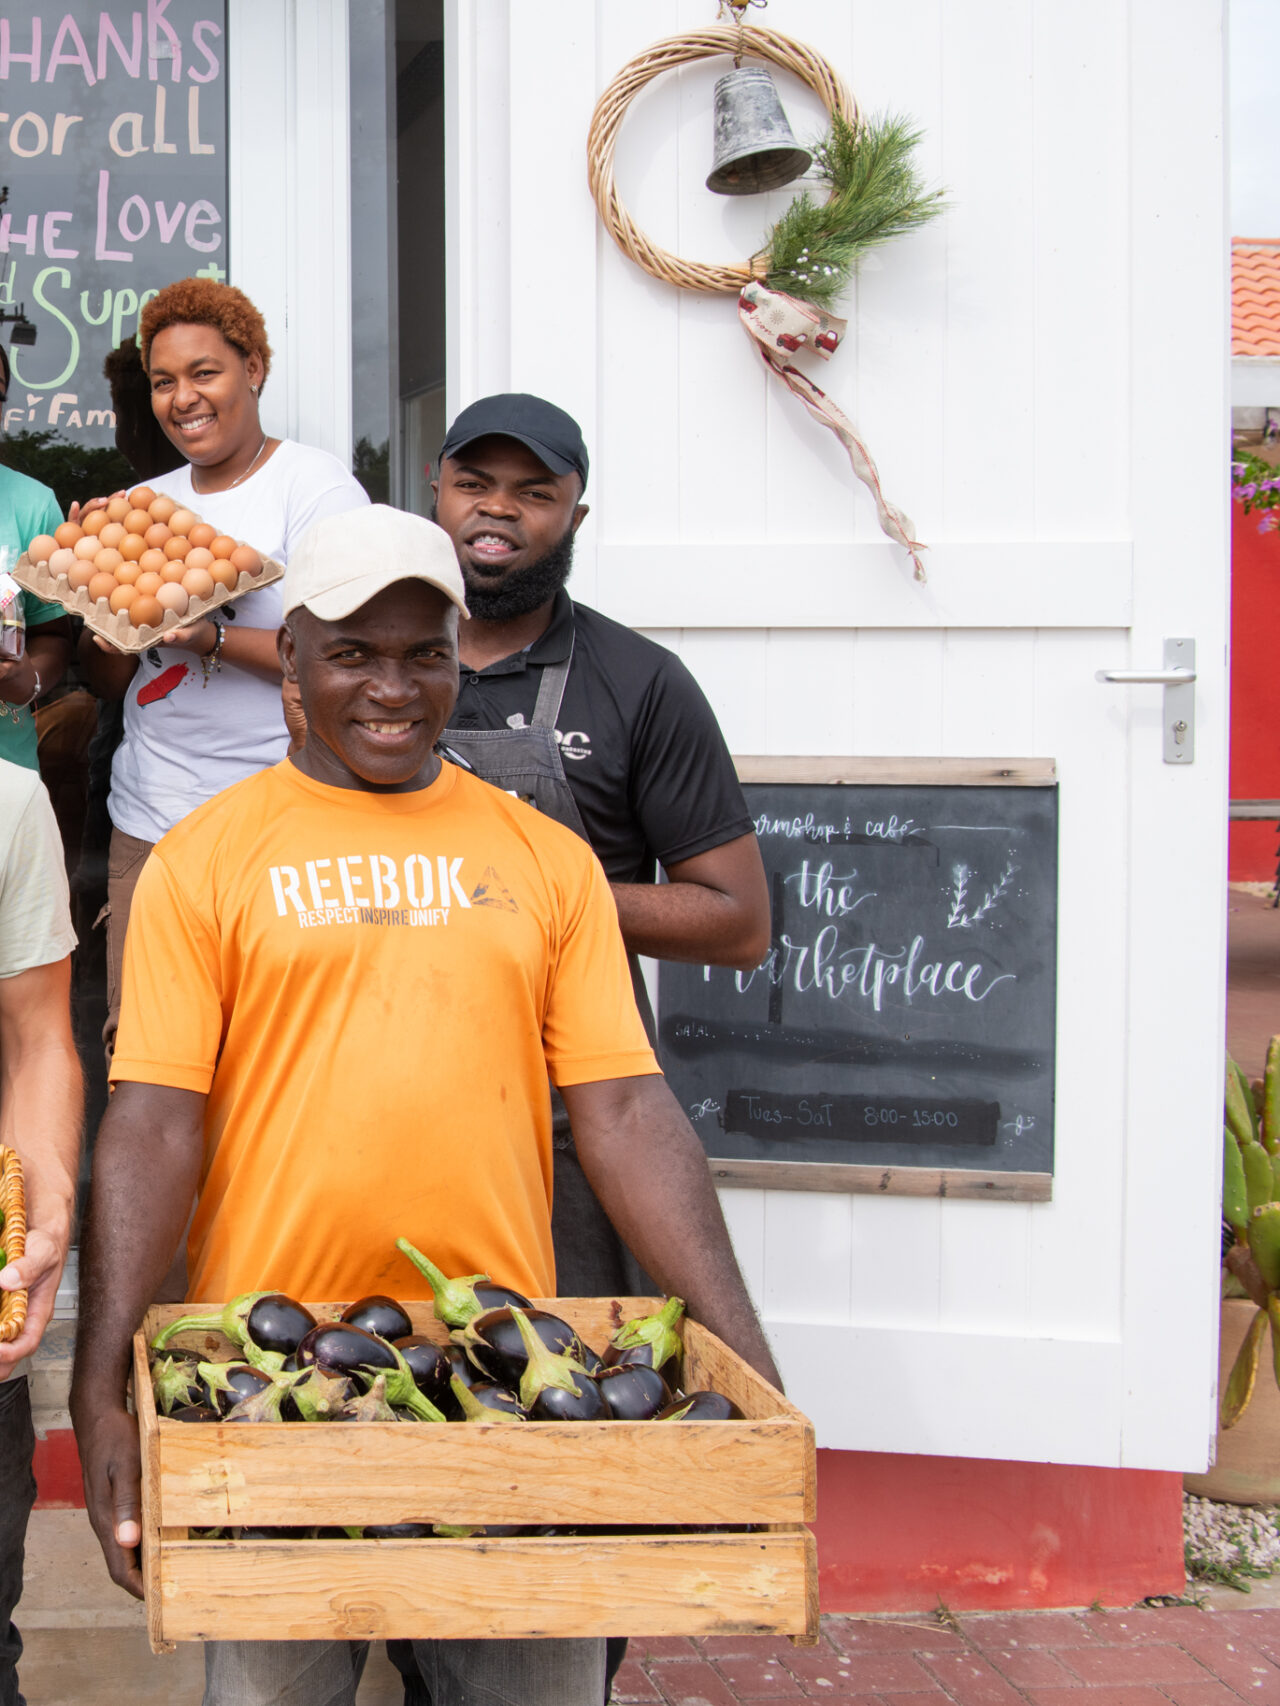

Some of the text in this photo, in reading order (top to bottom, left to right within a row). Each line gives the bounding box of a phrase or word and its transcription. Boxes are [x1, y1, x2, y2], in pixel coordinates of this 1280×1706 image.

[268, 853, 473, 917] REEBOK
[783, 860, 878, 917] the
[297, 907, 450, 929] RESPECT INSPIRE UNIFY
[703, 925, 1017, 1012] arketplace
